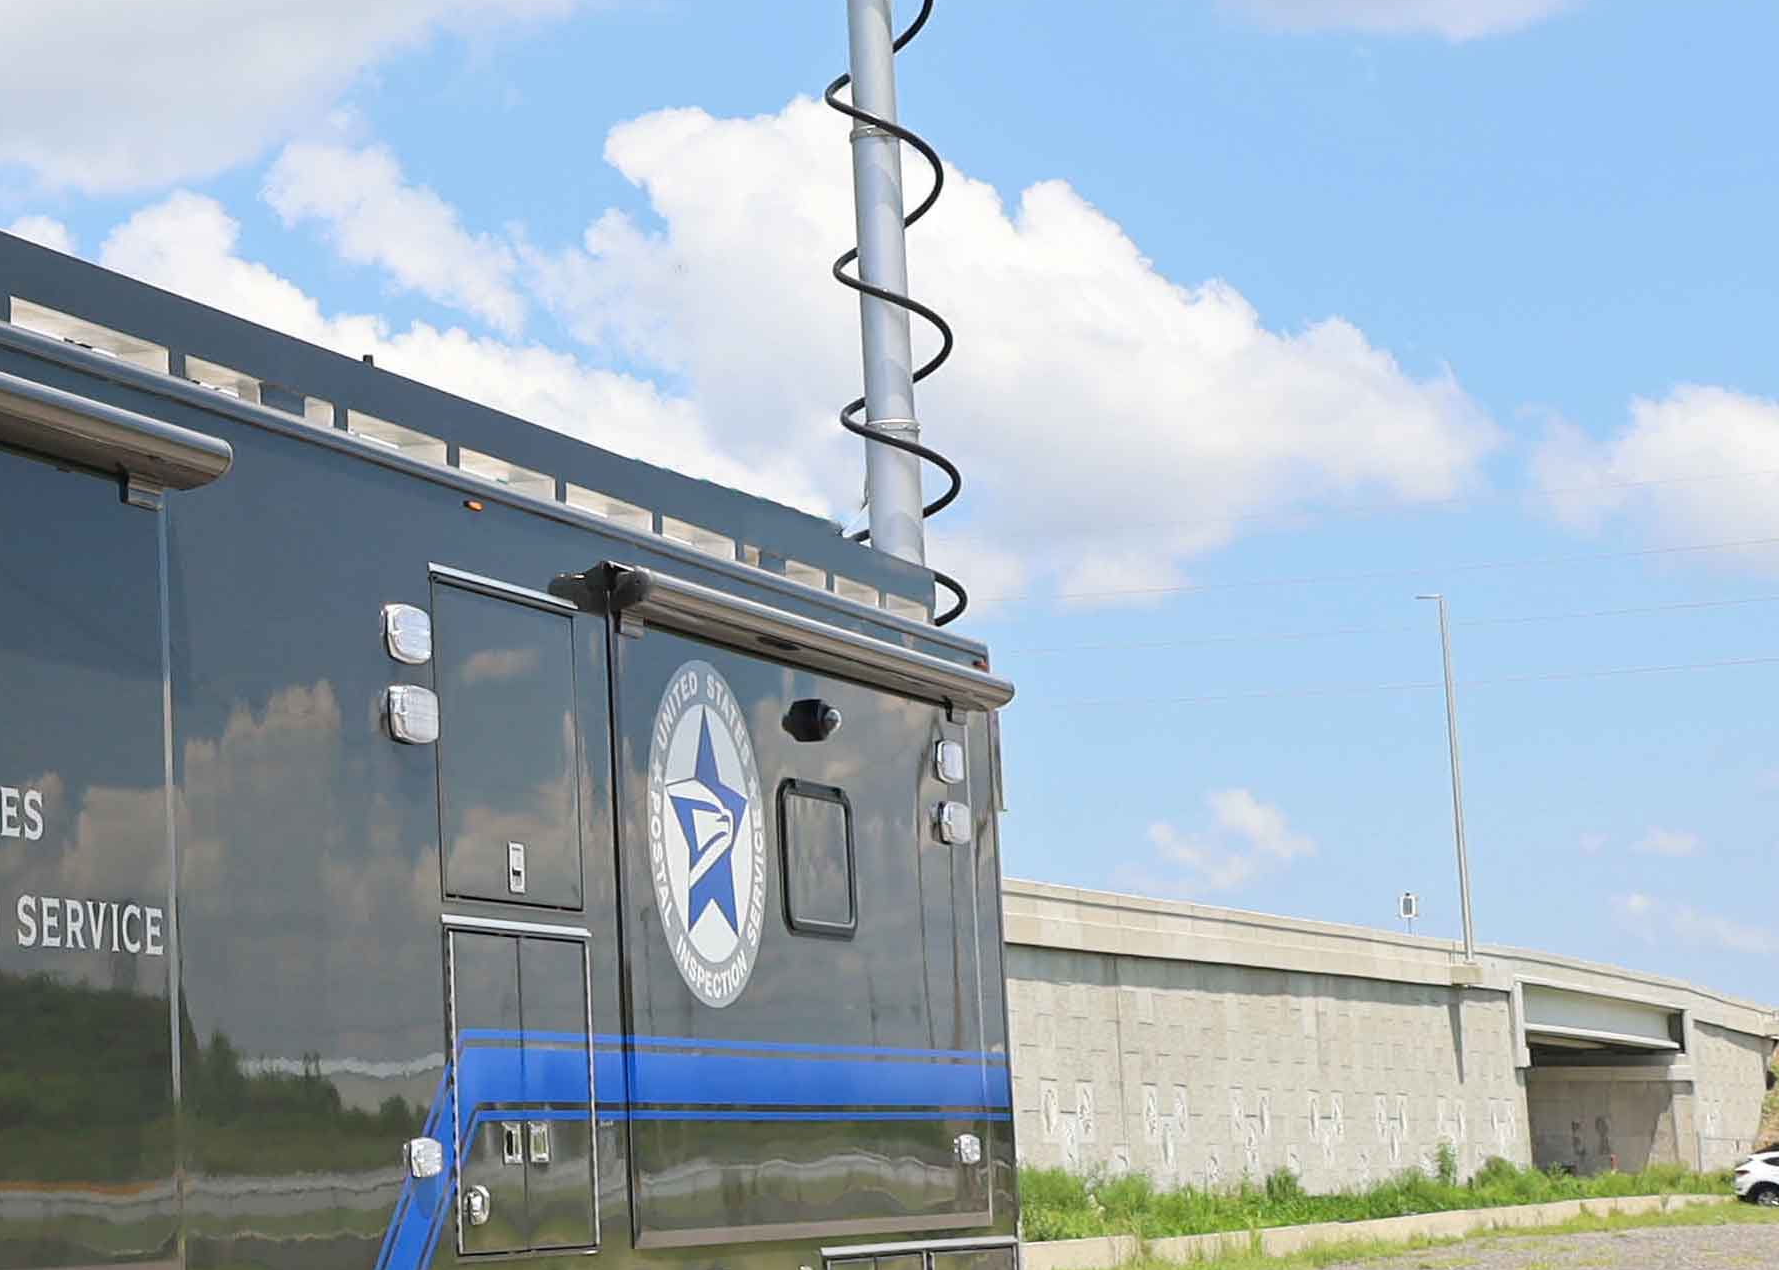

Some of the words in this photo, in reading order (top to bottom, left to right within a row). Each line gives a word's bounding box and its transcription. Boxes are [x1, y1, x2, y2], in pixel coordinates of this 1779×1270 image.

[657, 671, 698, 750] UNITED
[706, 674, 751, 769] STATES
[17, 894, 164, 956] SERVICE
[650, 790, 673, 927] POSTAL
[676, 935, 748, 999] INSPECTION
[745, 809, 764, 947] SERVICE
